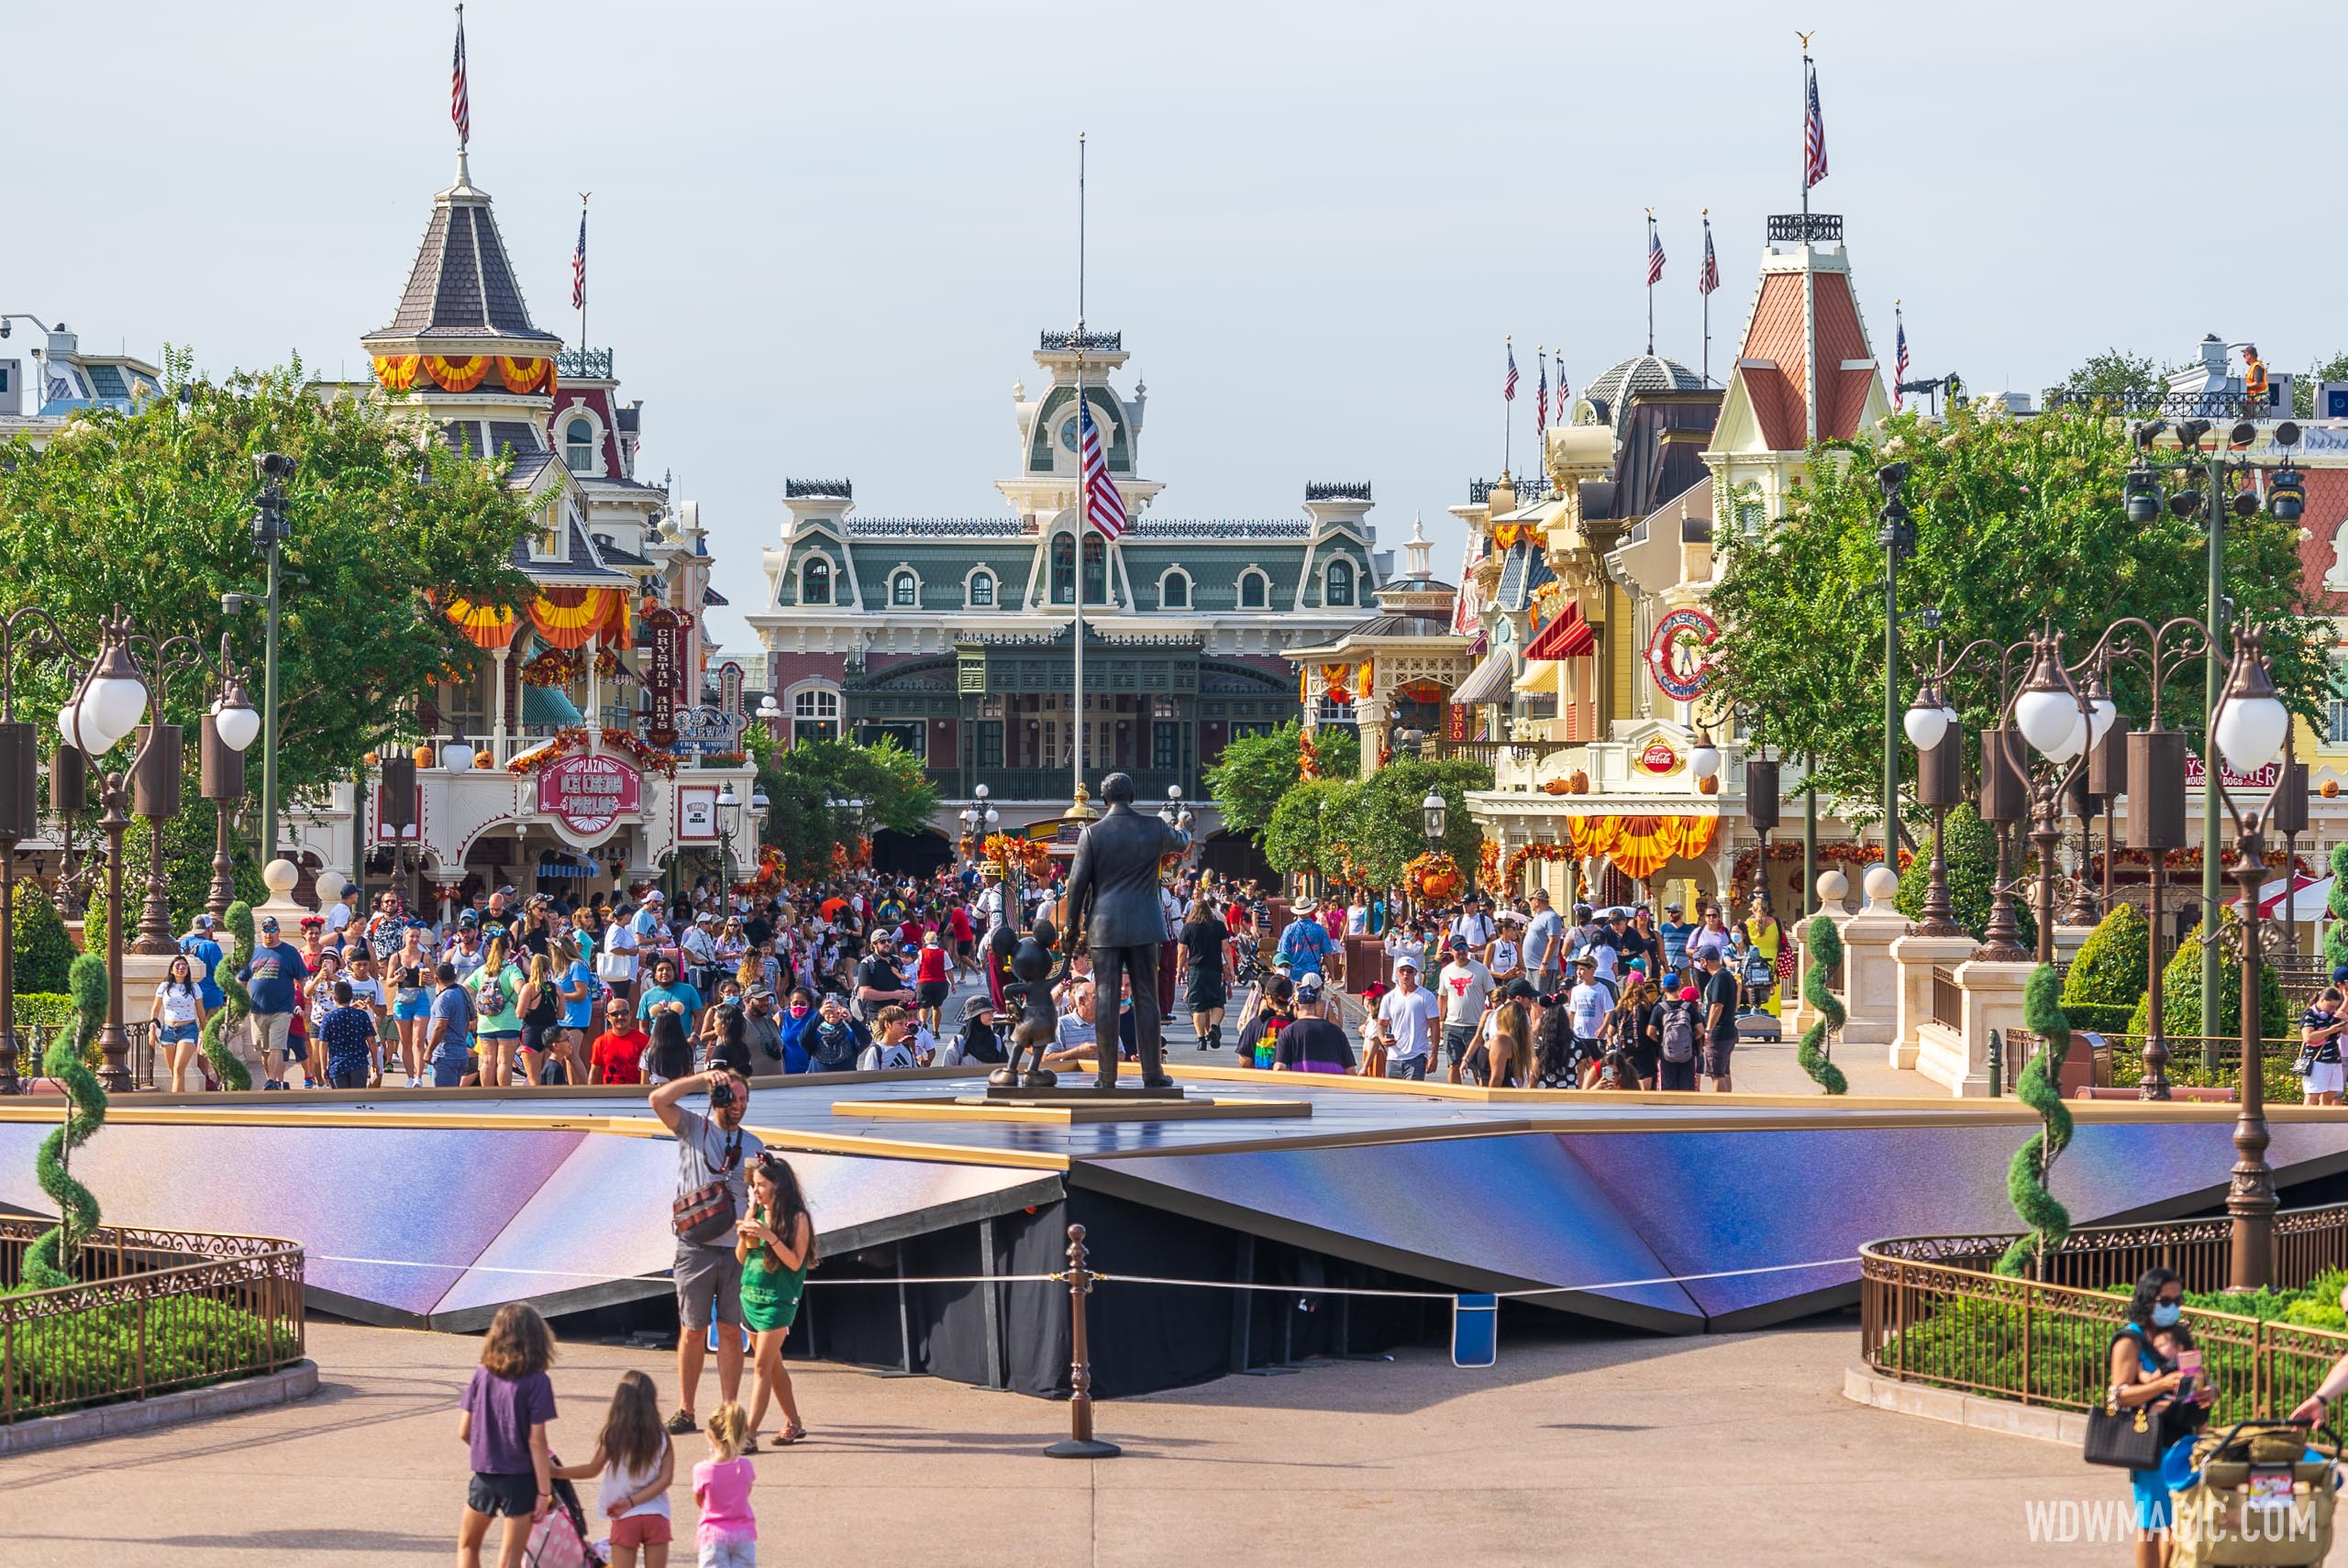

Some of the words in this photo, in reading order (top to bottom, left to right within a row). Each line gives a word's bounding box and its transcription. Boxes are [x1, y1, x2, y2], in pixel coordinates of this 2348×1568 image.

[657, 628, 669, 688] CRYSTAL
[657, 696, 669, 730] ARTS
[1453, 704, 1464, 739] EMPO
[579, 758, 603, 773] PLAZA
[1644, 752, 1672, 765] Coca-Cola
[560, 774, 581, 794] ICE
[582, 774, 624, 794] CREAM
[2222, 777, 2243, 786] DOGS
[569, 795, 613, 815] PARLOR
